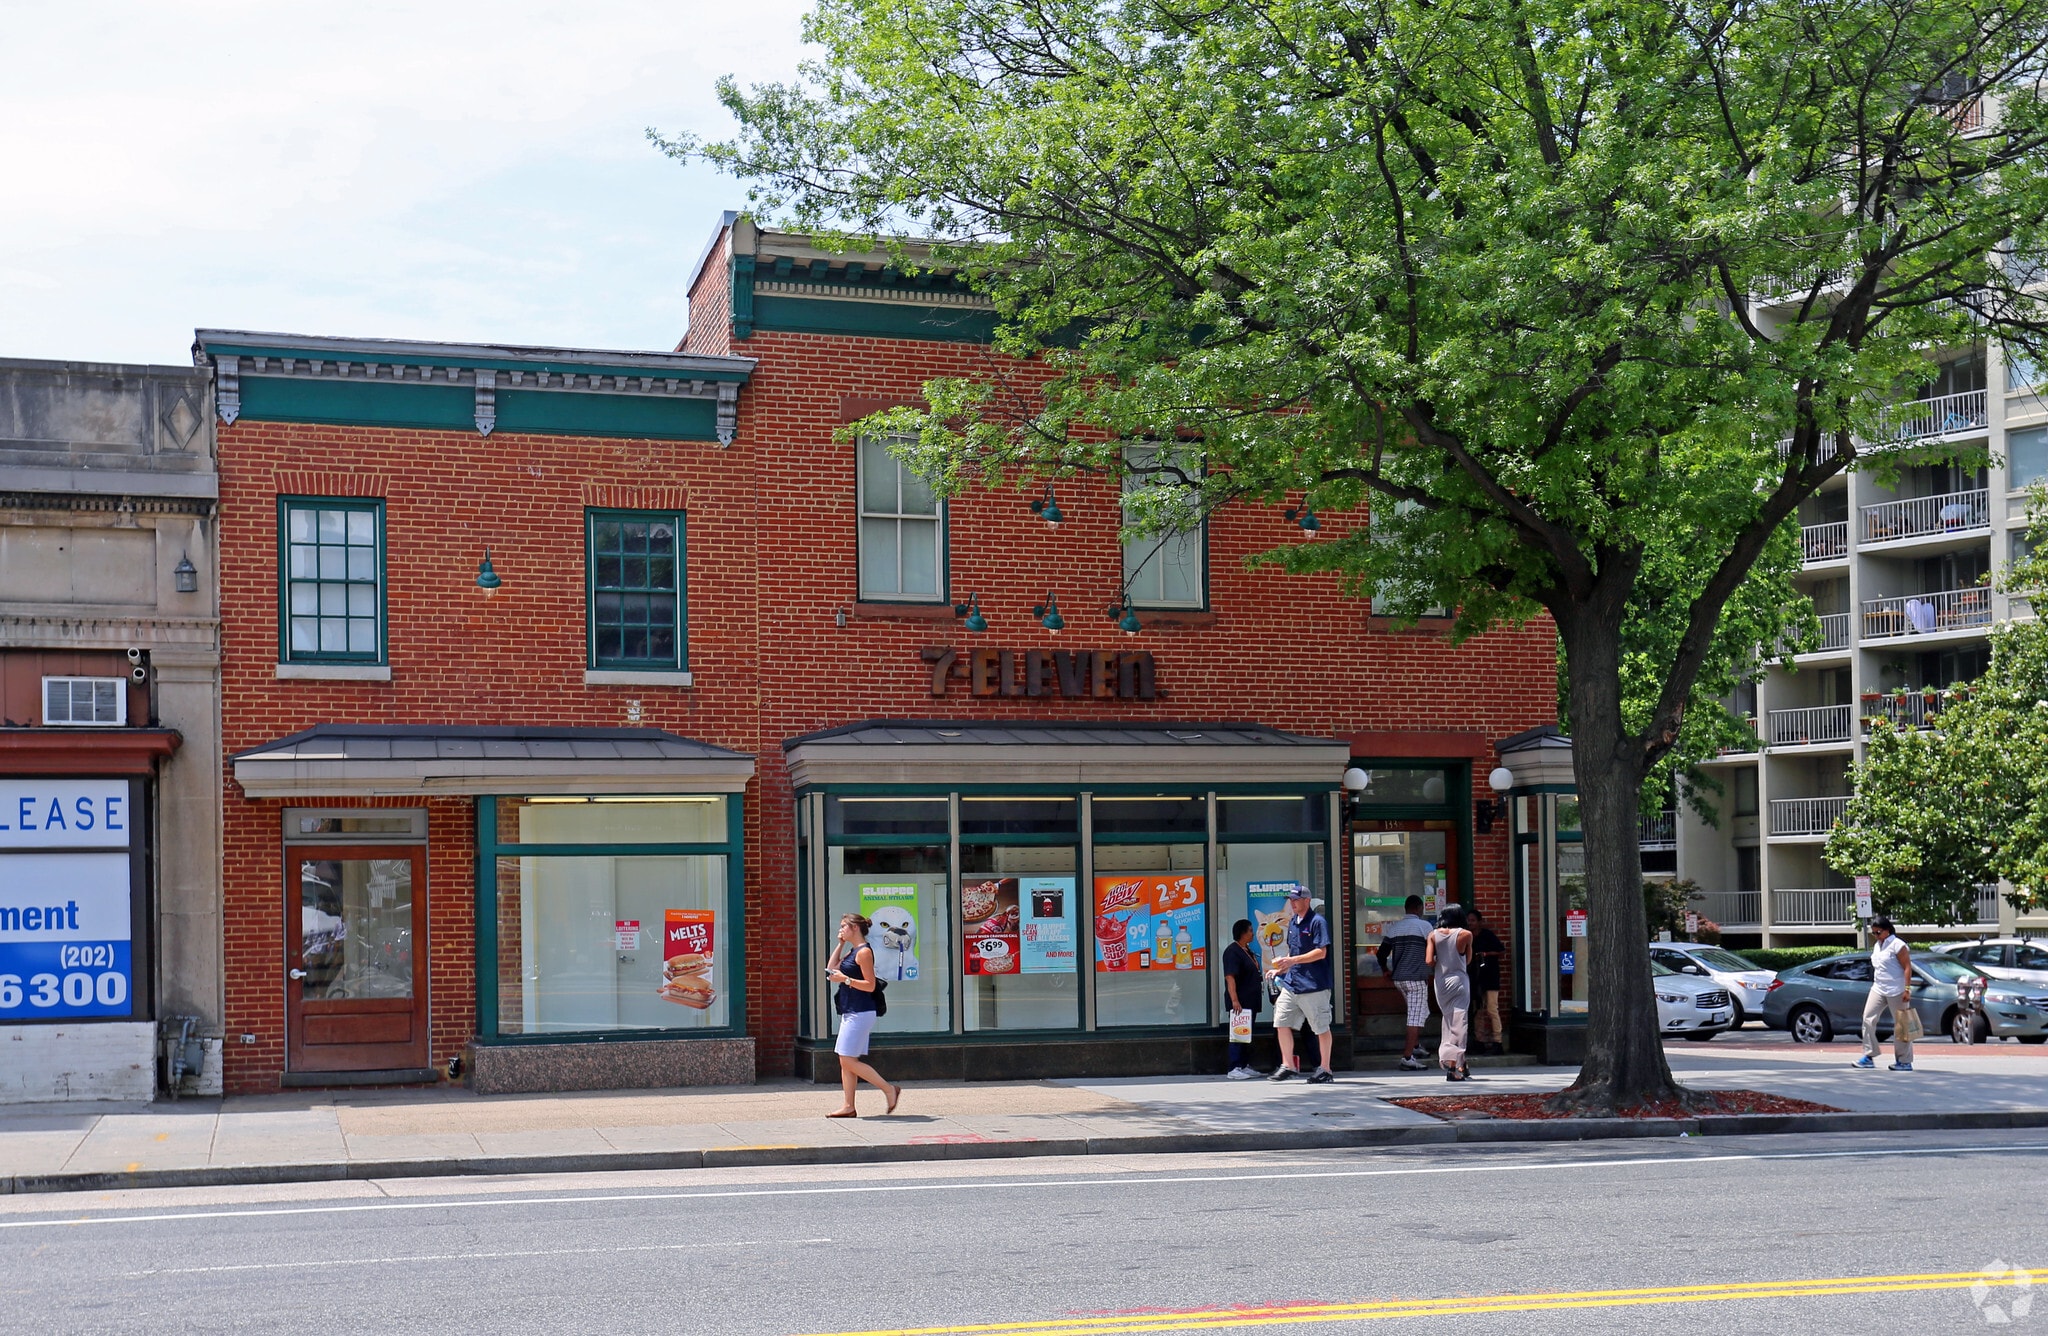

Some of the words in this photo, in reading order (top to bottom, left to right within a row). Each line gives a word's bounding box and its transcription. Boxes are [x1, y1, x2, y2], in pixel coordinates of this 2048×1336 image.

[670, 923, 706, 942] MELTS
[60, 944, 114, 969] (202)
[0, 971, 127, 1008] 6300
